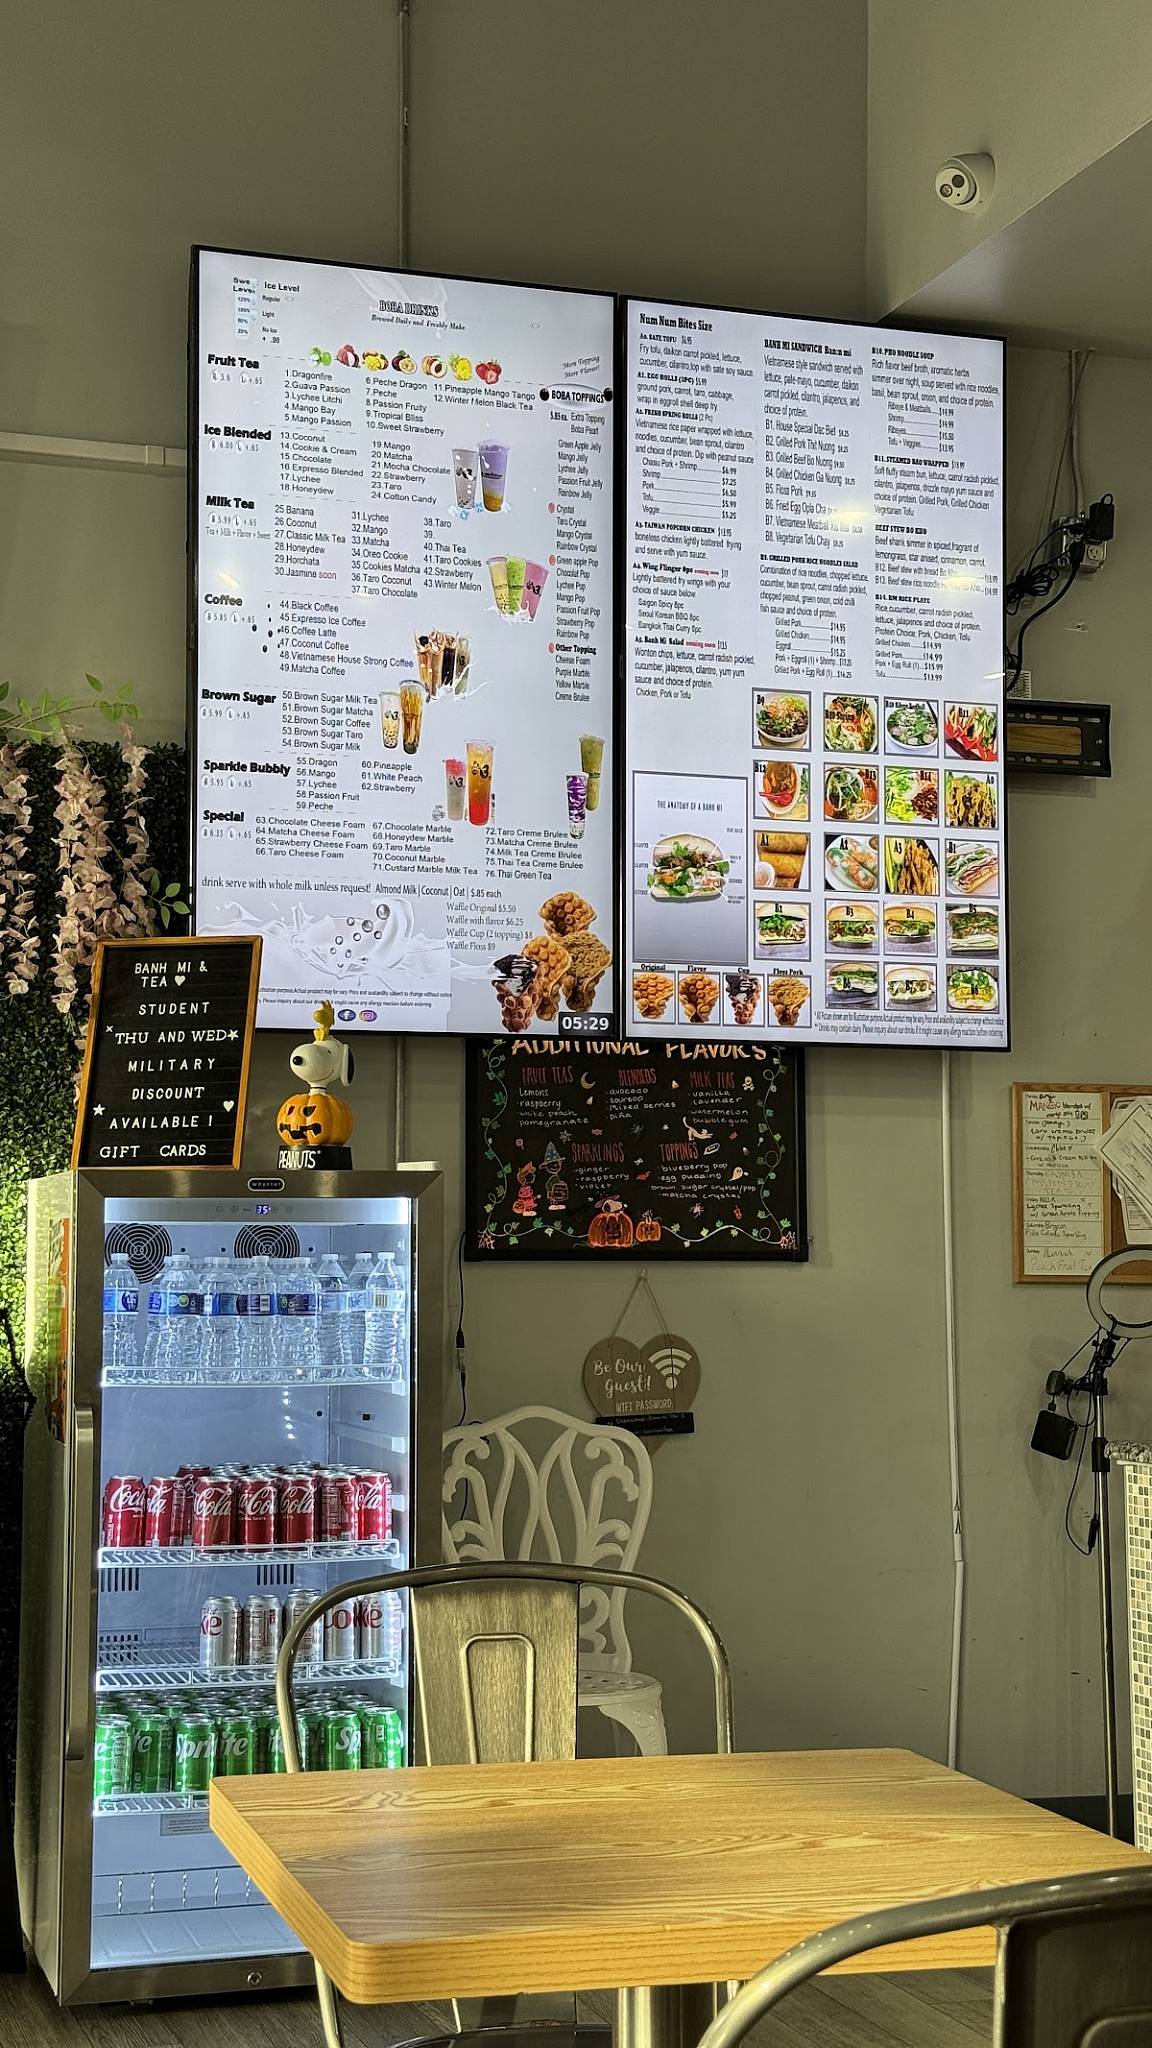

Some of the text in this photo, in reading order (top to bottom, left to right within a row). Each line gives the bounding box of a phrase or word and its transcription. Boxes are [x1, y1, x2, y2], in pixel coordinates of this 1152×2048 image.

[264, 281, 300, 292] Ice Level
[640, 313, 712, 331] Num Num Bites Size
[208, 354, 259, 369] Fruit Tea
[484, 389, 510, 399] Mango
[512, 391, 535, 400] Tango
[551, 390, 604, 403] BOBA TOPPINGS
[471, 397, 494, 407] Melon
[496, 400, 517, 409] Black
[519, 402, 533, 411] Tea
[204, 425, 271, 440] Ice Blended
[206, 495, 254, 509] Milk Tea
[315, 533, 329, 542] Milk
[331, 534, 345, 543] Tea
[205, 594, 242, 606] Coffee
[328, 617, 339, 626] Ice
[342, 618, 366, 627] Coffee
[337, 654, 361, 664] House
[363, 656, 387, 668] Strong
[390, 658, 414, 667] Coffee
[202, 689, 276, 705] Brown Sugar
[321, 694, 344, 704] Sugar
[346, 695, 361, 704] Milk
[363, 696, 377, 705] Tea
[204, 760, 290, 776] Sparkle Bubbly
[203, 810, 244, 823] Special
[313, 839, 343, 848] Cheese
[345, 841, 368, 850] Foam
[514, 870, 536, 880] Green
[538, 871, 552, 881] Tea
[202, 876, 223, 887] drink
[225, 879, 247, 888] serve
[249, 878, 266, 889] with
[269, 879, 292, 890] whole
[295, 881, 312, 891] milk
[314, 882, 338, 892] unless
[376, 884, 401, 894] Almond
[486, 888, 501, 898] each
[446, 902, 516, 914] Waffle Original $5.50
[446, 915, 468, 925] Waffle
[470, 916, 483, 925] with
[506, 917, 523, 927] $6.25
[446, 928, 468, 938] Waffle
[470, 929, 484, 940] Cup
[446, 941, 468, 951] Waffle
[487, 942, 495, 951] $9
[134, 961, 208, 974] BANH MI &
[141, 976, 167, 988] TEA
[139, 1002, 210, 1015] STUDENT
[562, 1017, 609, 1030] 05:29
[115, 1029, 227, 1044] THU AND WED
[128, 1058, 215, 1072] MILITARY
[132, 1087, 205, 1100] DISCOUNT
[109, 1116, 199, 1130] AVAILABLE
[100, 1145, 207, 1159] GIFT CARDS
[660, 1142, 699, 1162] TOPPINGS
[278, 1150, 316, 1169] PEANUTS
[593, 1358, 645, 1375] Be Our
[616, 1398, 672, 1412] WIFI PASSWORD
